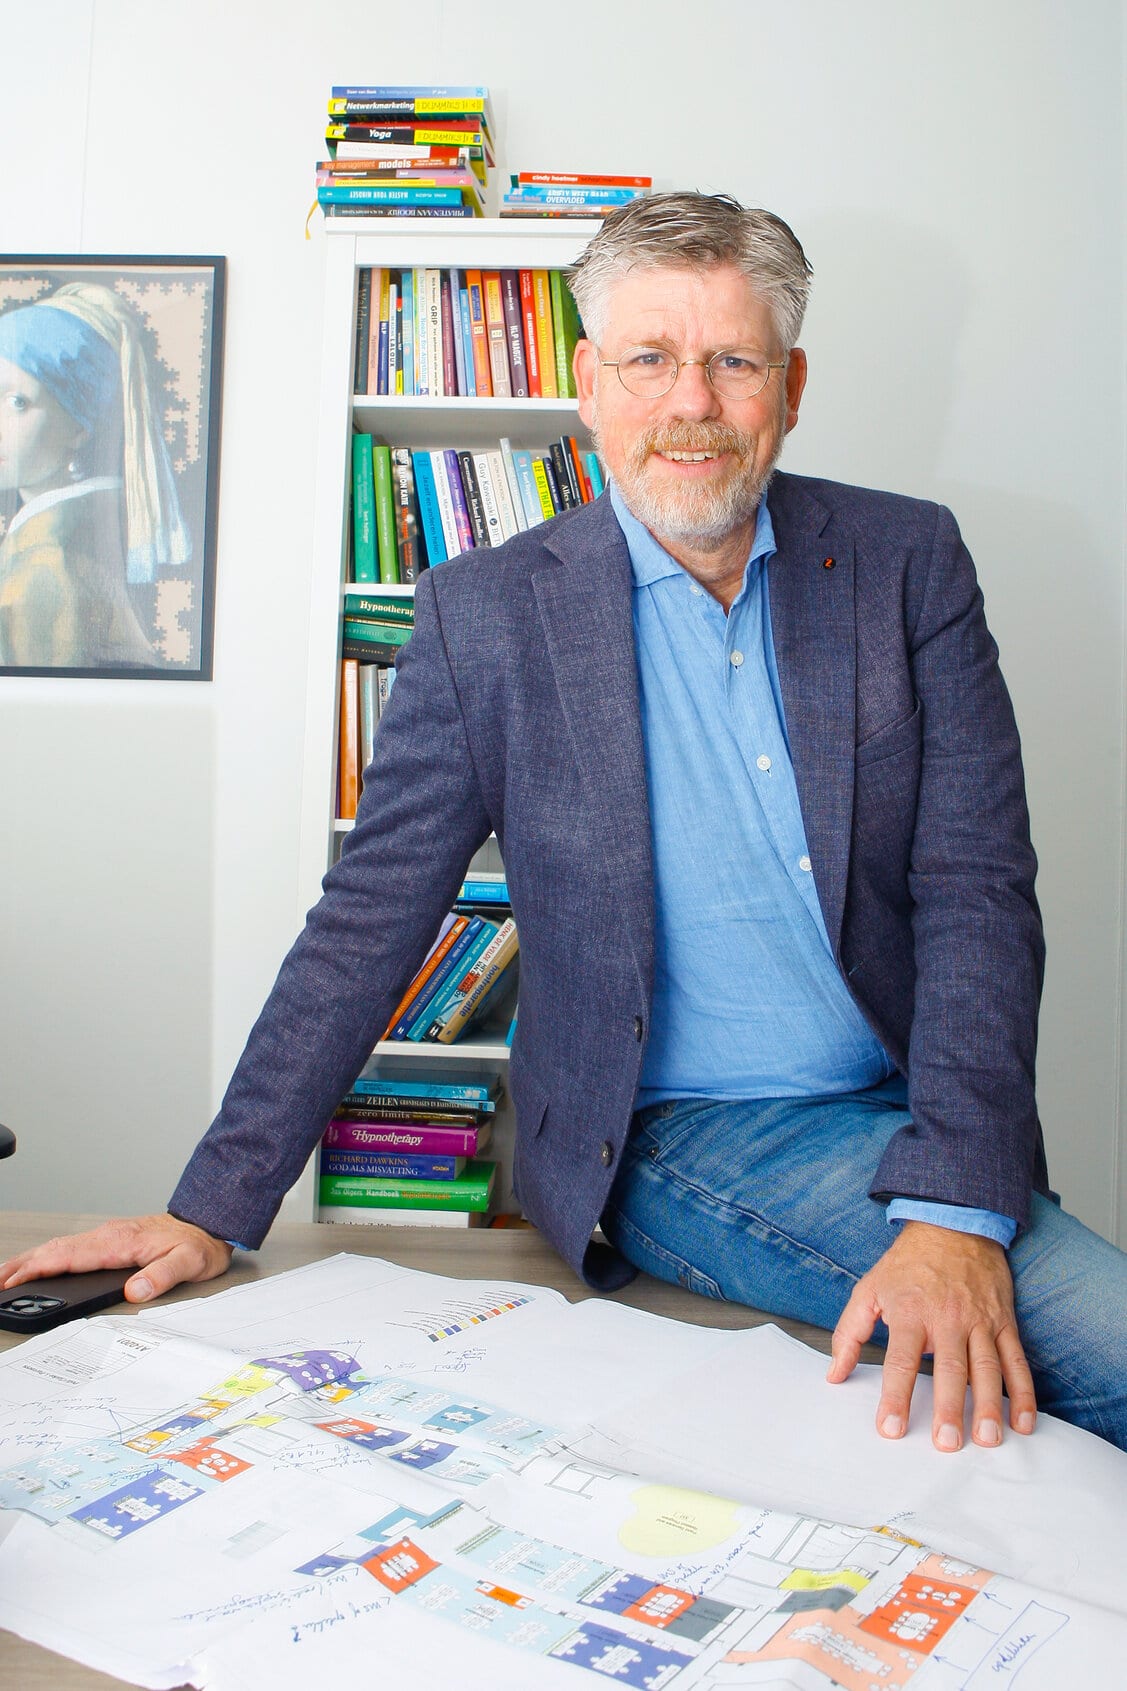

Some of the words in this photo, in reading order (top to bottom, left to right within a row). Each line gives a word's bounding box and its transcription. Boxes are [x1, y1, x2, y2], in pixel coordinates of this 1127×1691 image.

[347, 102, 415, 111] Netwerkmarketing
[421, 100, 462, 109] DUMMIES
[369, 129, 391, 139] Yoga
[423, 133, 462, 142] DUMMIES
[337, 160, 375, 169] management
[378, 159, 411, 168] models
[357, 288, 368, 330] Walden
[510, 325, 518, 338] NLP
[537, 476, 546, 489] EAT
[400, 490, 408, 505] KATIE
[483, 480, 495, 517] Kawasaki
[540, 492, 551, 509] THAT
[561, 484, 570, 503] Alles
[471, 498, 479, 518] Richard
[475, 519, 484, 538] Bandler
[427, 507, 436, 534] anderen
[432, 536, 440, 555] helen
[360, 600, 414, 618] Hypnotherap
[500, 922, 513, 939] HENK
[483, 946, 497, 961] VELDE
[474, 960, 483, 971] VAN
[366, 1096, 399, 1106] ZEILEN
[381, 1109, 410, 1118] limits
[352, 1130, 423, 1146] Hypnotherapy
[330, 1155, 368, 1164] RICHARD
[369, 1157, 408, 1165] DAWKINS
[366, 1167, 418, 1176] MISVATTING
[366, 1189, 399, 1198] Handboek
